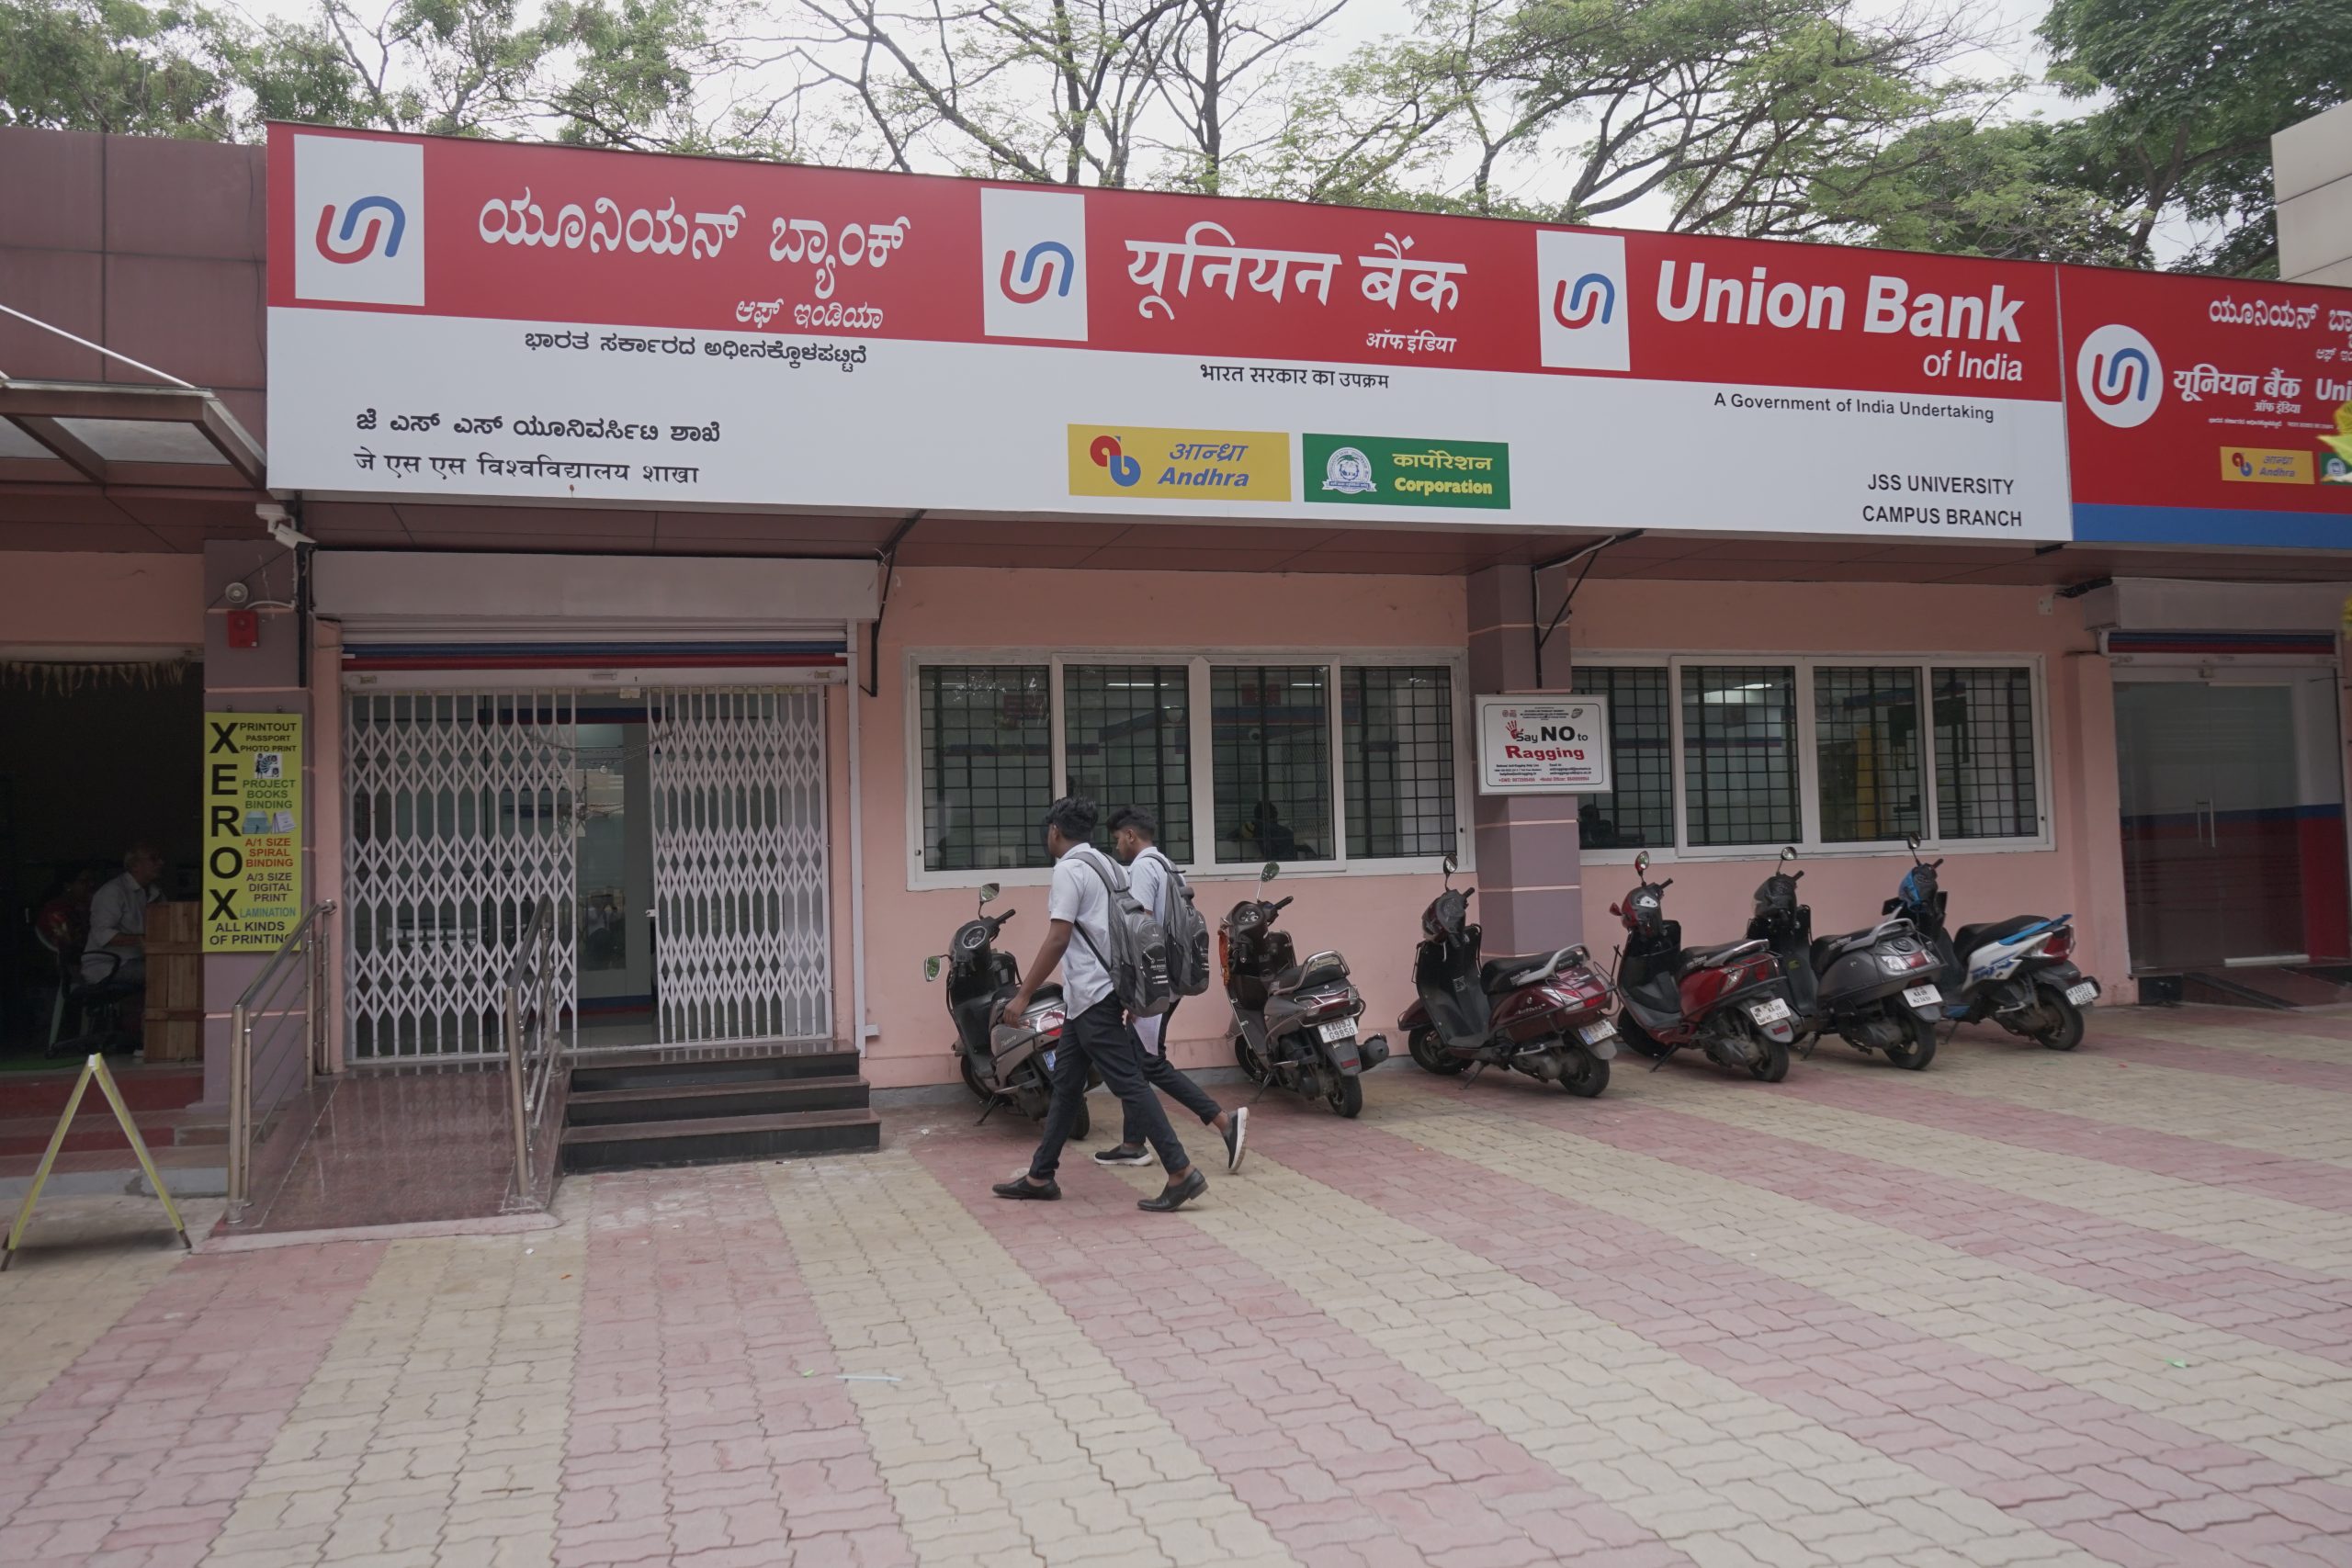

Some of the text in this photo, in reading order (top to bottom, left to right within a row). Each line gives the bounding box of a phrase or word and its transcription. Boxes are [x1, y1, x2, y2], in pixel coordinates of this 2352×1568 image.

[479, 186, 911, 299] ಯೂನಿಯನ್ ಬ್ಯಾಂಕ್
[1124, 220, 1468, 321] यूनियन बैंक
[1657, 260, 2025, 343] Union Bank
[735, 298, 884, 330] ಆಫ್ ಇಂಡಿಯಾ
[2209, 295, 2319, 330] ಯೂನಿಯನ್
[525, 330, 590, 351] ಭಾರತ
[600, 333, 695, 355] ಸರ್ಕಾರದ
[1365, 328, 1457, 354] ऑफ इंडिया
[1923, 349, 2023, 381] of India
[1200, 364, 1390, 389] भारत सरकार का उपक्रम
[2173, 363, 2302, 402] यूनियन बैंक
[2316, 378, 2352, 400] Uni
[1713, 392, 1994, 423] A Government of India Undertaking
[390, 412, 441, 433] ಎಸ್
[453, 415, 503, 434] ಎಸ್
[513, 414, 659, 441] ಯೂನಿವರ್ಸಿಟಿ
[670, 421, 720, 443] ಶಾಖೆ
[353, 446, 700, 484] जे एस एस विश्वविद्यालय शाखा
[2259, 467, 2296, 478] Andhra
[1158, 467, 1250, 487] Andhra
[1867, 473, 2014, 495] JSS UNIVERSITY
[1394, 477, 1493, 496] Corporation
[1862, 505, 2022, 527] CAMPUS BRANCH
[239, 722, 297, 732] PRINTOUT
[1516, 726, 1589, 744] Say NO to
[245, 734, 291, 742] PASSPORT
[240, 744, 270, 752] PHOTO
[1504, 745, 1585, 761] Ragging
[242, 779, 296, 789] PROJECT
[246, 789, 288, 799] BOOKS
[244, 800, 293, 809] BINDING
[209, 721, 243, 921] XEROX
[244, 837, 291, 847] A/1 SIZE
[249, 848, 290, 857] SPIRAL
[245, 858, 294, 868] BINDING
[245, 872, 292, 882] A/3 SIZE
[248, 883, 293, 892] DIGITAL
[254, 893, 288, 902] PRINT
[239, 907, 296, 919] LAMINATION
[215, 920, 286, 933] ALL KINDS
[209, 934, 228, 946] OF
[1325, 1018, 1351, 1032] KA09J
